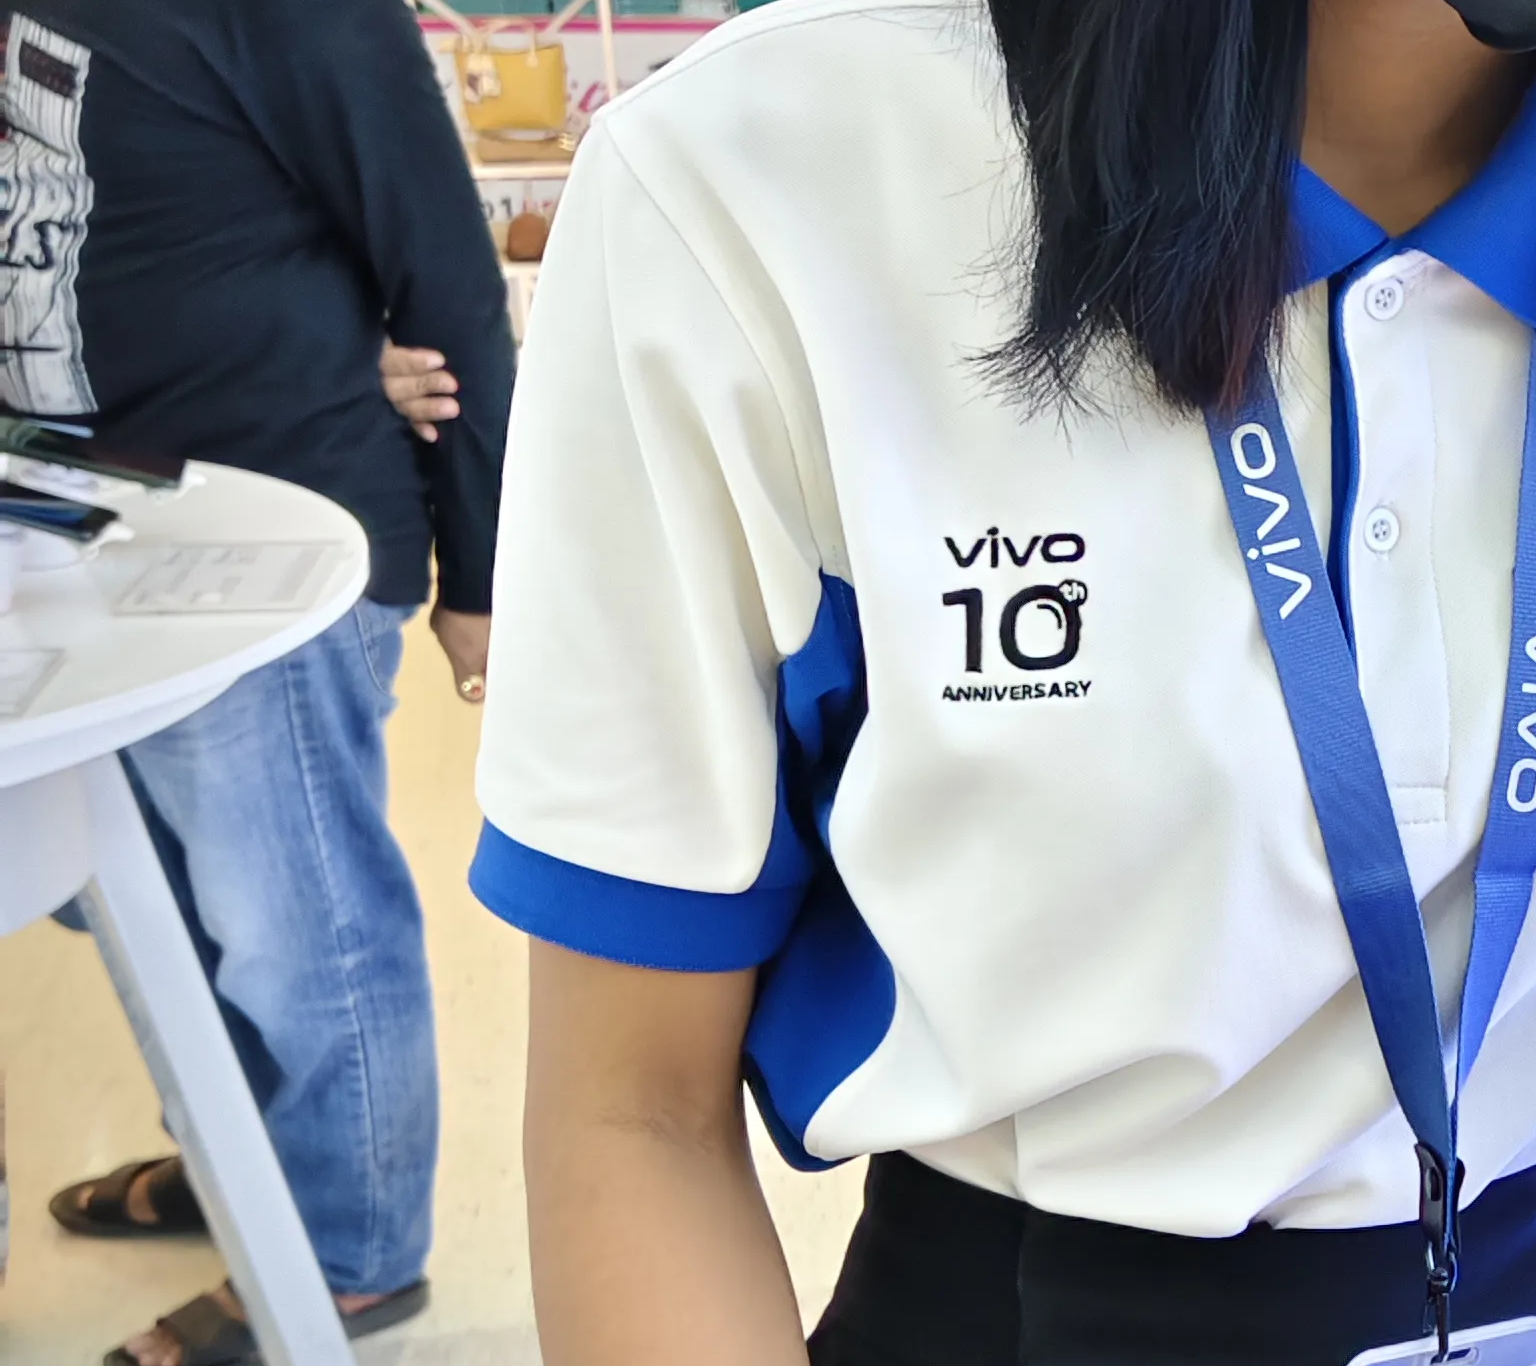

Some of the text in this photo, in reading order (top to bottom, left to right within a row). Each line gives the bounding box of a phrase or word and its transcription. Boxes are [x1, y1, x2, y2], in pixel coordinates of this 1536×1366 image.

[1231, 422, 1312, 621] vivo
[943, 525, 1086, 569] vivo
[941, 680, 1092, 702] ANNIVERSARY
